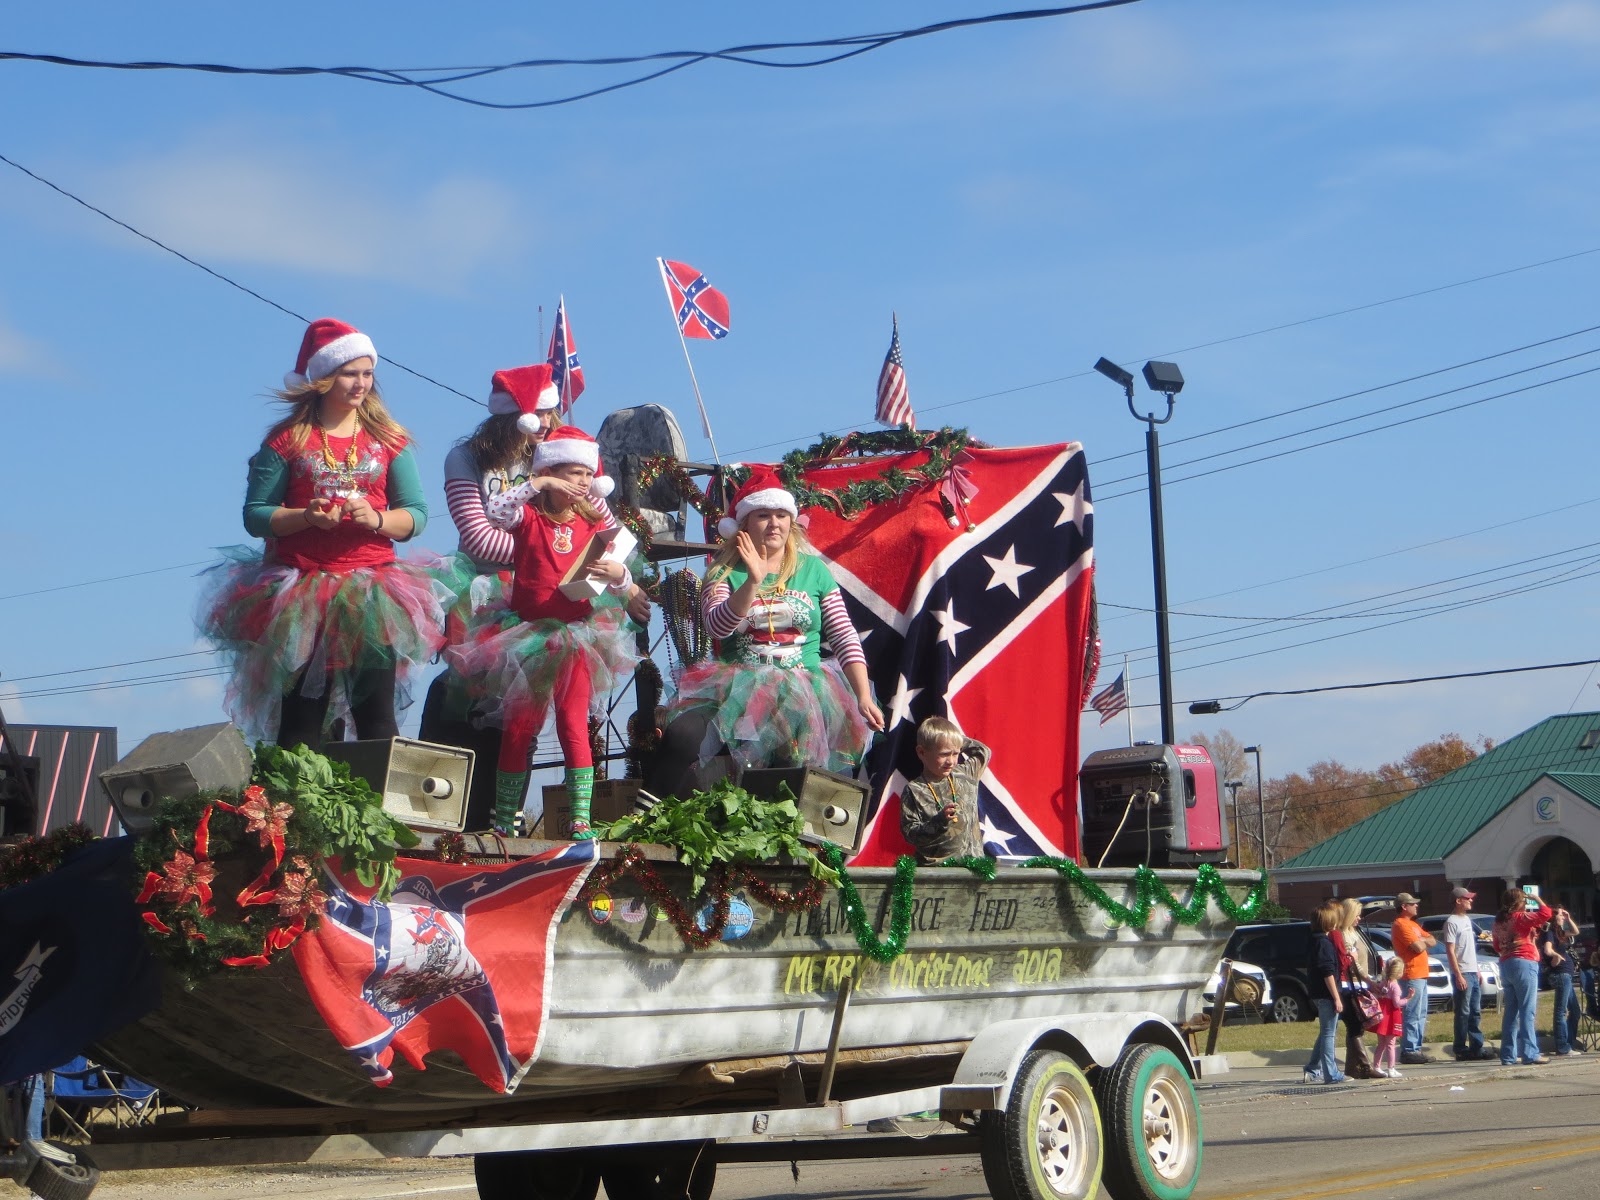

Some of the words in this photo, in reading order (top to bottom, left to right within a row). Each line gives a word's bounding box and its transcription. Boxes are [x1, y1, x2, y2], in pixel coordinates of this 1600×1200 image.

[1103, 751, 1147, 760] HONDA
[877, 892, 945, 934] FRCE
[968, 891, 1018, 932] FEED
[784, 954, 868, 994] MERRY
[889, 951, 993, 991] Christmas
[1012, 947, 1063, 985] 2012
